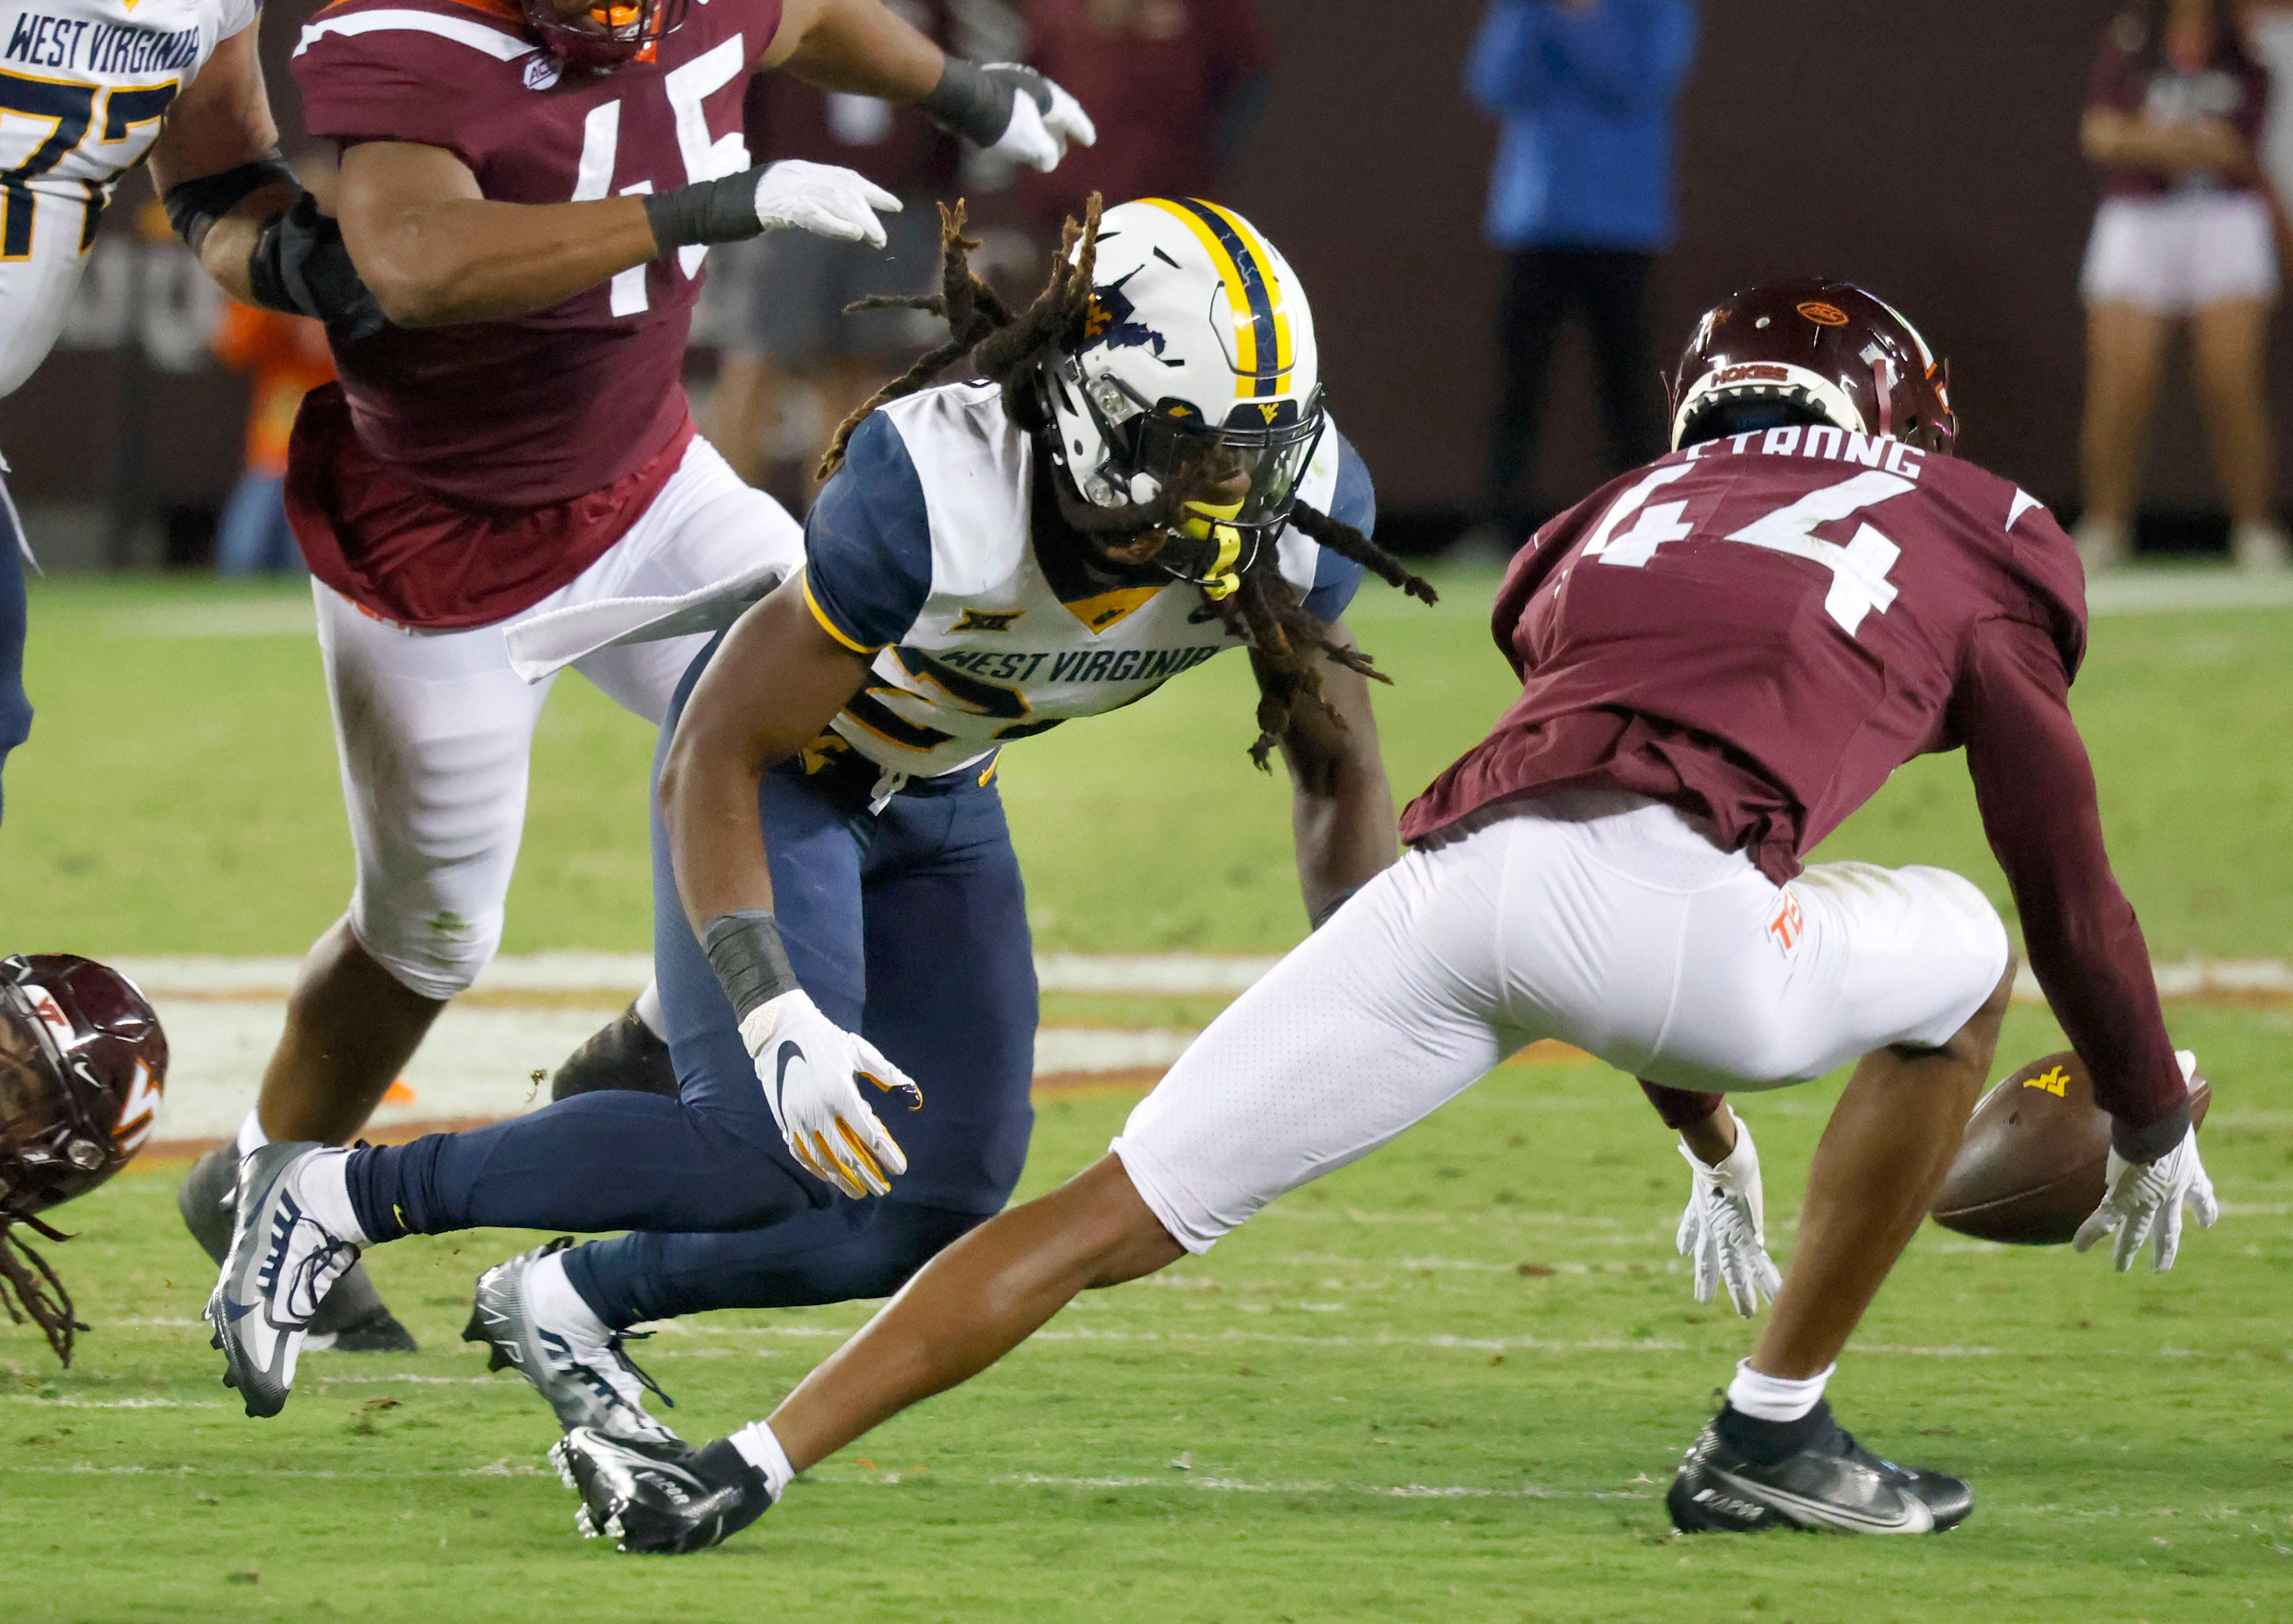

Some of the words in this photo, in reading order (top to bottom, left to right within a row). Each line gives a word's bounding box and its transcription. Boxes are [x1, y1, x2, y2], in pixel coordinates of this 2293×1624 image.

[6, 12, 89, 69] WEST
[88, 25, 199, 74] VIRGINIA
[1710, 365, 1788, 388] HOKIES
[1581, 462, 1917, 637] 44
[939, 650, 1051, 682] WEST
[1048, 645, 1224, 682] VIRGINIA
